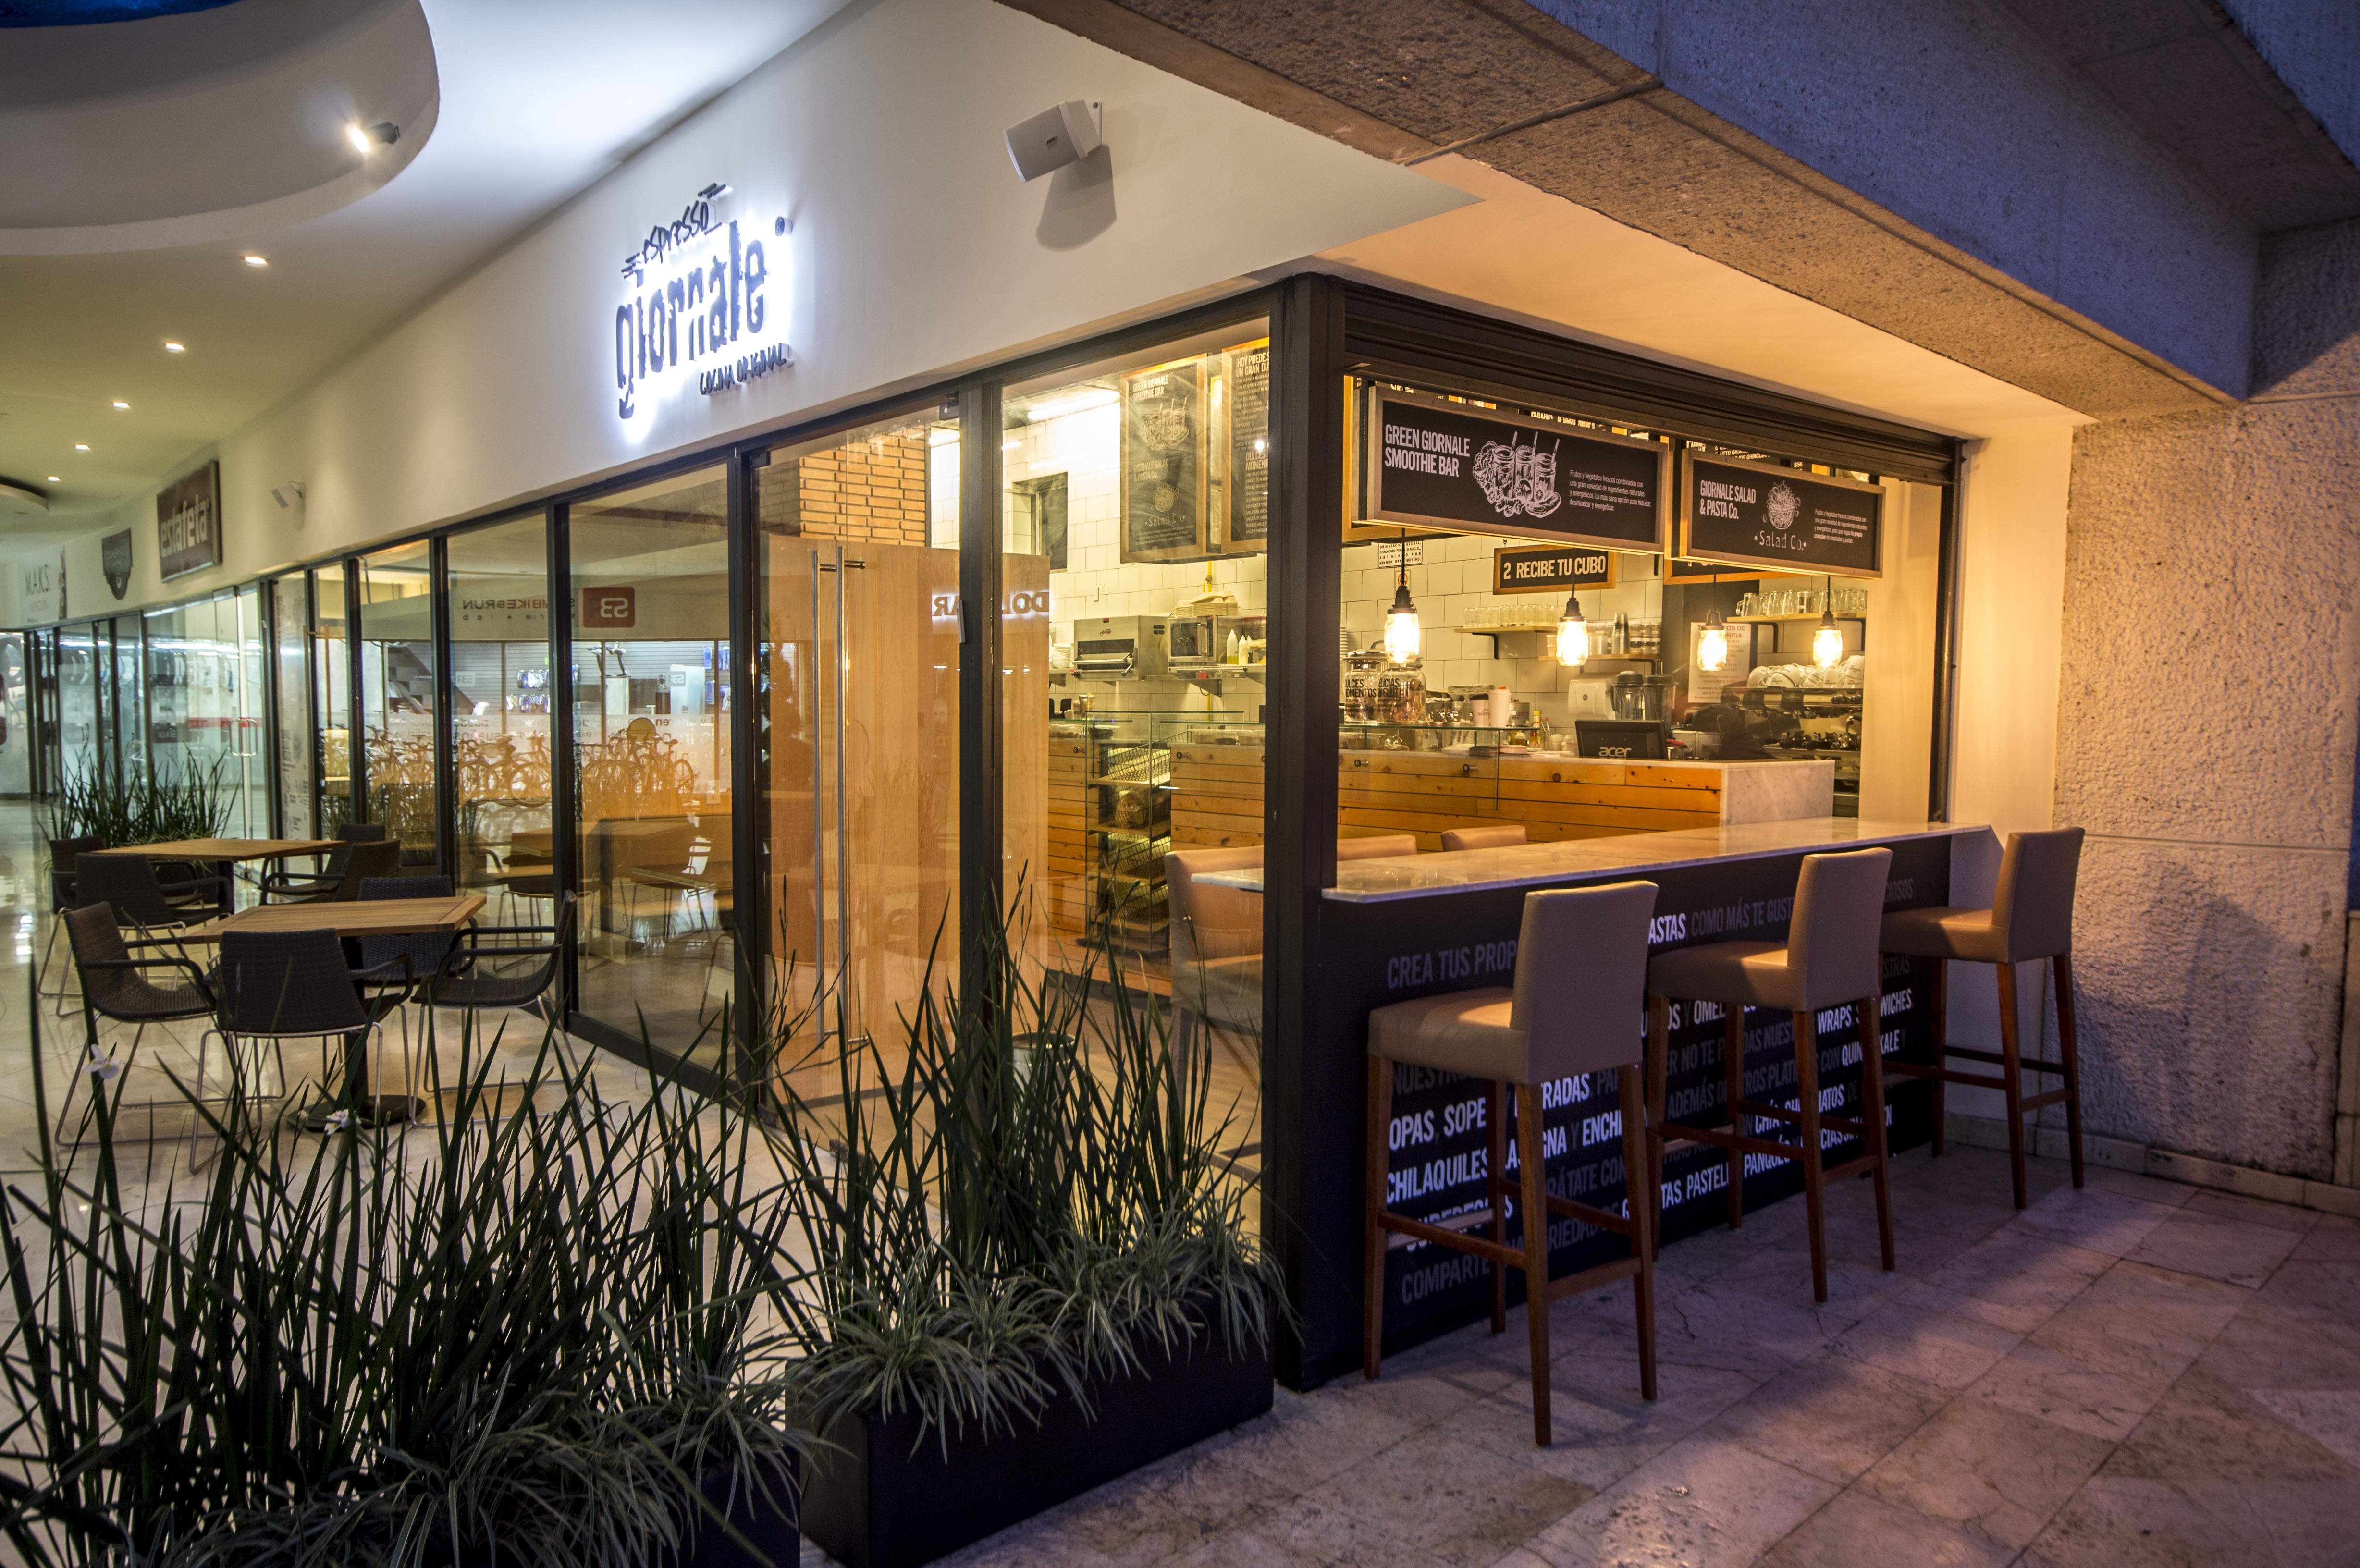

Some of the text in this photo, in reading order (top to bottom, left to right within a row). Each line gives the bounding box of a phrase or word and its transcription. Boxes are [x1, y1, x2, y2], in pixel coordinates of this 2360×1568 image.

[643, 201, 708, 264] espresso
[616, 220, 767, 419] giornale
[737, 343, 787, 382] ORIGINAL
[1248, 352, 1266, 365] PUEDE
[1236, 367, 1243, 377] UN
[1245, 364, 1260, 375] GRAN
[1133, 375, 1168, 392] GREEN GIORNALE
[1133, 386, 1164, 401] SMOOTHIE BAR
[1385, 424, 1470, 457] GREEN GIORNALE
[1133, 458, 1168, 472] GIORNALE SALAD
[1246, 450, 1266, 461] DULCES
[1246, 459, 1268, 471] MOMENT
[1385, 447, 1459, 477] SMOOTHIE BAR
[1134, 474, 1137, 482] &
[1138, 472, 1151, 481] PASTA
[1570, 469, 1582, 478] Frutos
[1586, 472, 1602, 481] Vegetales
[1603, 475, 1615, 483] frescos
[1616, 478, 1636, 487] combinados
[1608, 486, 1629, 494] ingredientes
[1700, 480, 1756, 504] GIORNALE SALAD
[1569, 499, 1591, 508] desintoxicar
[1595, 503, 1614, 511] energetizar.
[1700, 498, 1739, 519] & PASTA Co.
[161, 494, 207, 558] estafeta
[1149, 514, 1169, 527] Salad
[1759, 530, 1787, 548] Salad
[1504, 556, 1606, 579] 2 RECIBE TU CUBO
[1599, 747, 1632, 757] acer
[1691, 907, 1724, 937] COMO
[1726, 897, 1750, 931] MÁS
[1753, 901, 1765, 927] TE
[1767, 896, 1795, 923] GUST
[1388, 940, 1518, 989] CREA TUS PROP
[1684, 1001, 1692, 1027] Y
[1682, 1043, 1698, 1072] NO
[1700, 1039, 1715, 1066] TE
[1667, 1076, 1715, 1121] ADEMÁS
[1820, 1046, 1840, 1074] CON
[1842, 1041, 1863, 1067] QUIN
[1443, 1097, 1487, 1138] SOPE
[1570, 1122, 1580, 1150] Y
[1546, 1162, 1598, 1199] RÁTATE
